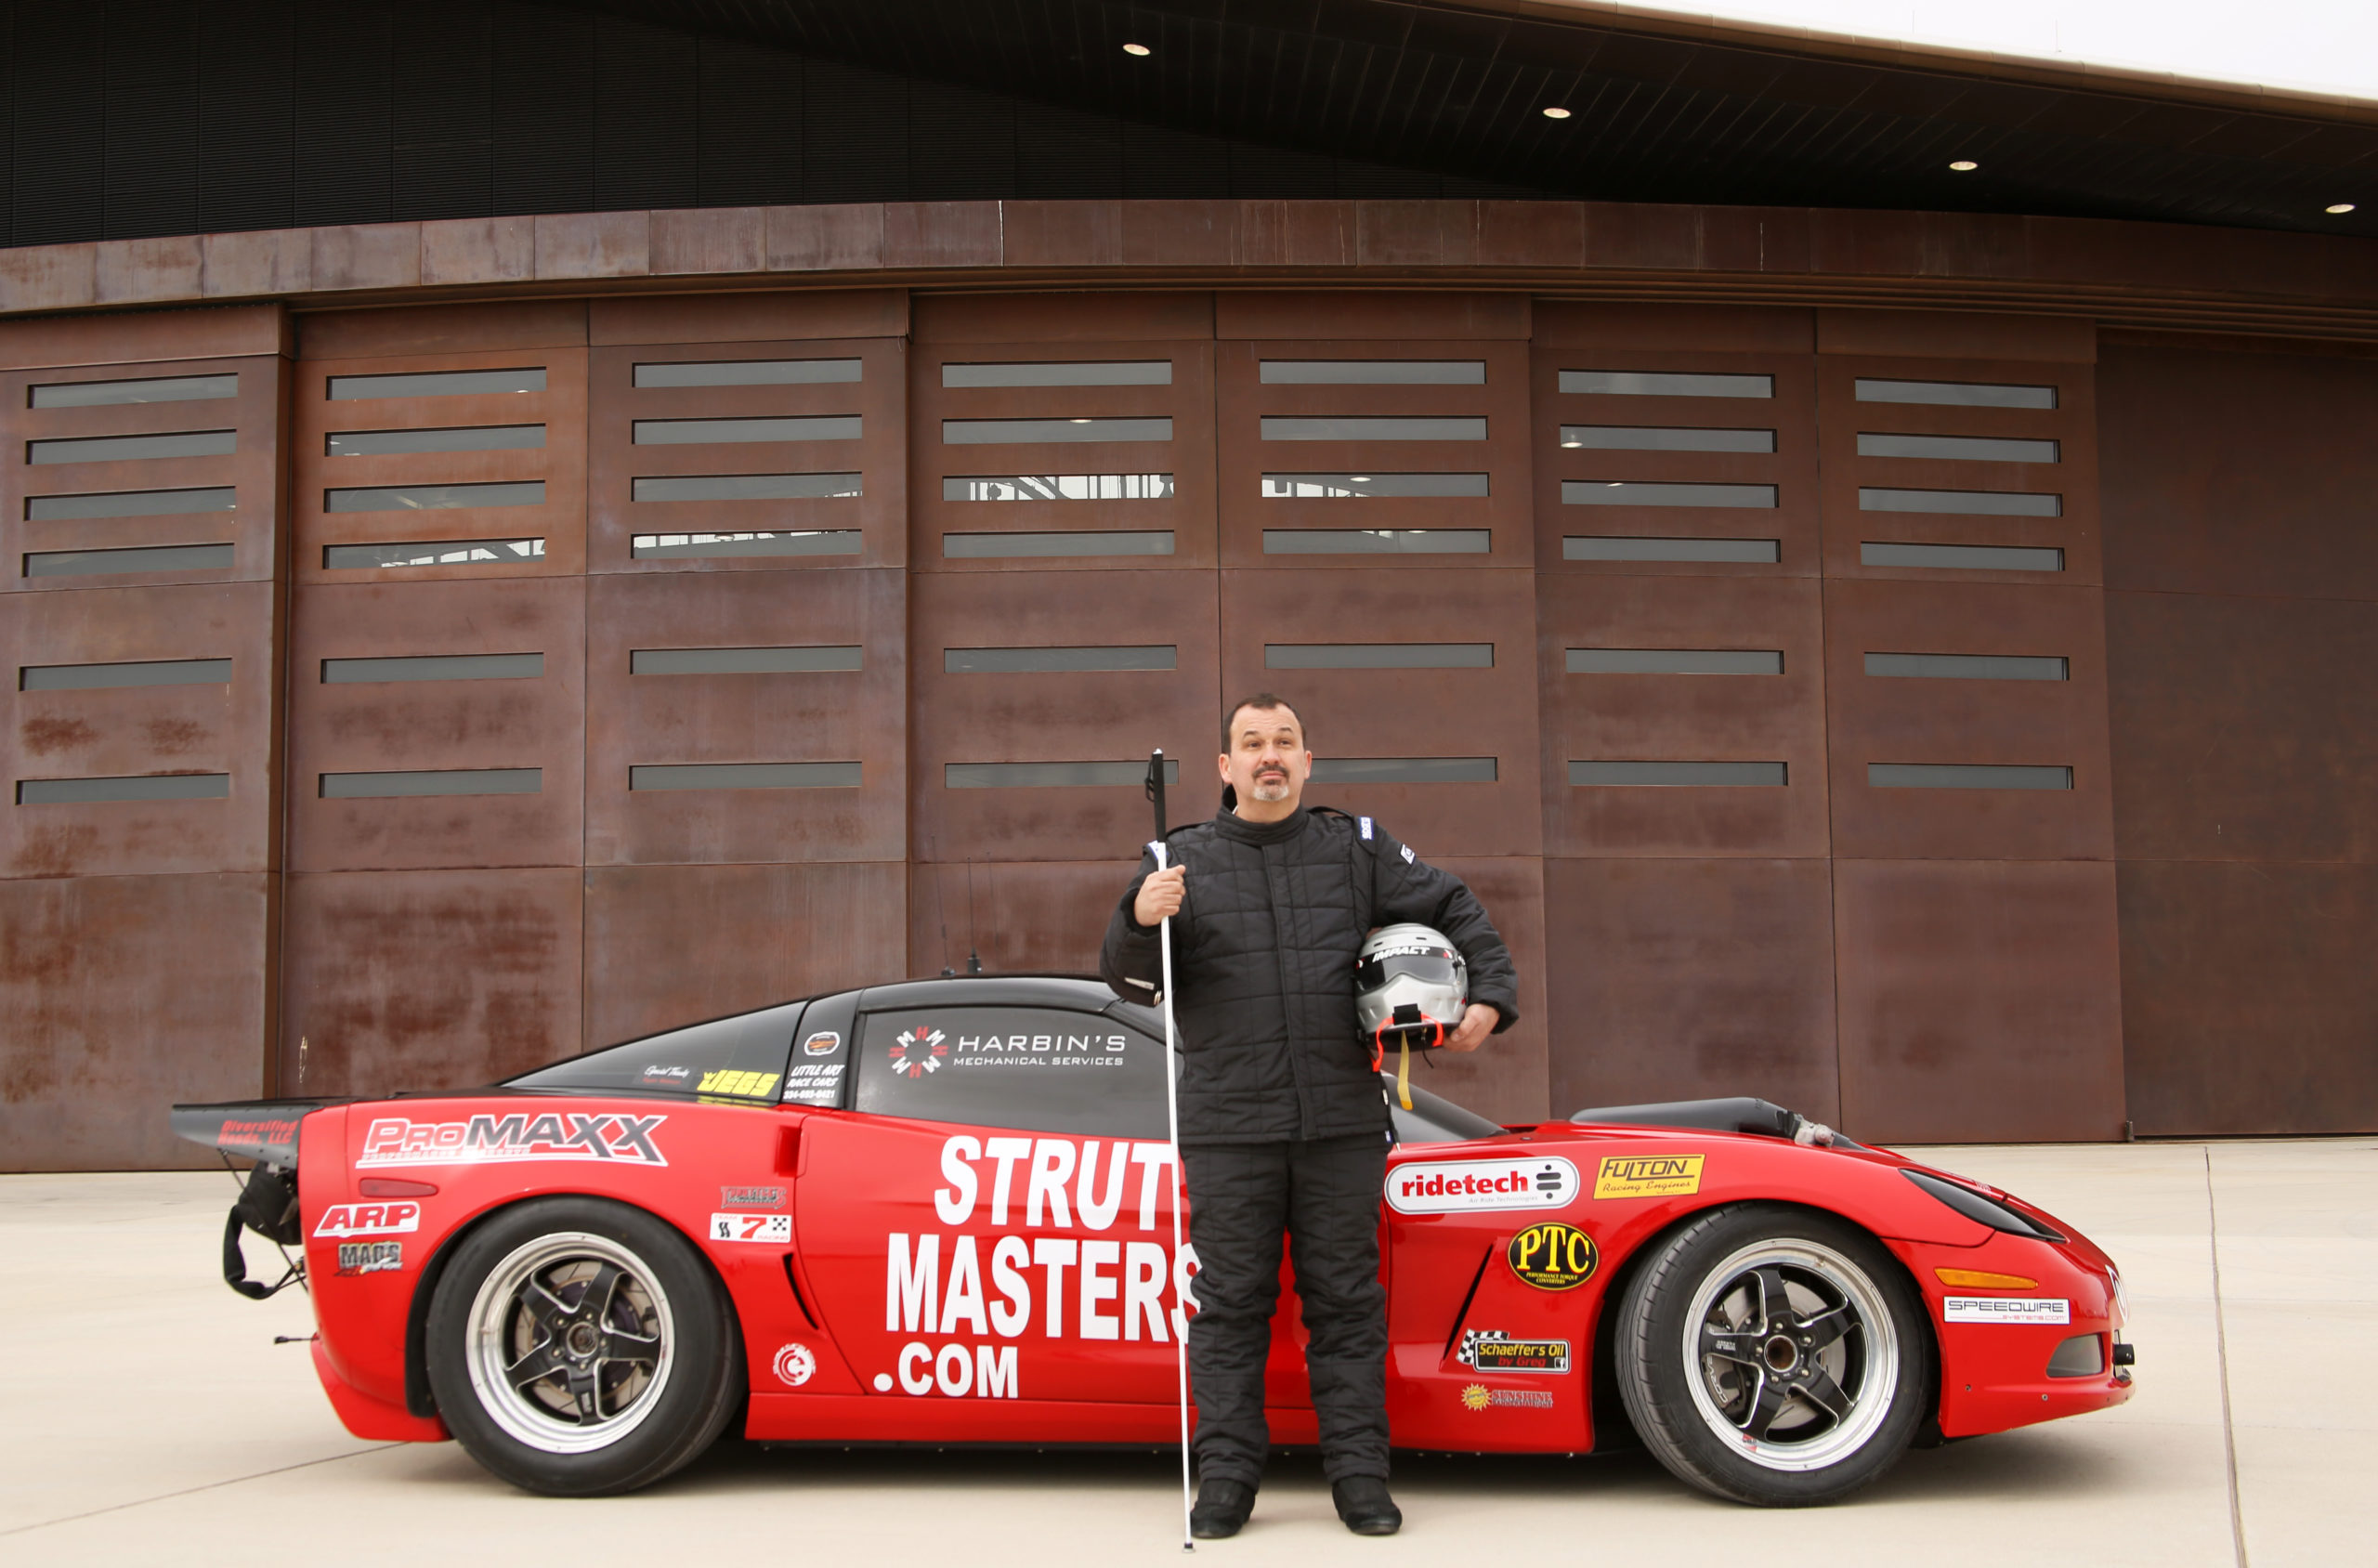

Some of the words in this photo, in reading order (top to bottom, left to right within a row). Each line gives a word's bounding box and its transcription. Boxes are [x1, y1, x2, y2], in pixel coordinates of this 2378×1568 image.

[1372, 946, 1431, 963] IMPACT
[958, 1035, 1126, 1052] HARBIN'S
[954, 1057, 1047, 1066] MECHANICAL
[1052, 1057, 1124, 1066] SERVICES
[790, 1065, 824, 1078] LITTLE
[821, 1065, 845, 1077] ART
[698, 1070, 780, 1097] JEGS
[787, 1078, 813, 1088] RACE
[812, 1078, 840, 1087] CARS
[221, 1119, 299, 1132] Diversified
[268, 1132, 293, 1144] LLC
[1601, 1157, 1694, 1181] FULTON
[934, 1135, 1179, 1231] STRUT
[1402, 1170, 1529, 1196] ridetech
[1602, 1183, 1641, 1193] Racing
[1645, 1181, 1691, 1191] Engines
[320, 1204, 417, 1230] ARP
[740, 1216, 767, 1239] 7
[1517, 1226, 1589, 1274] PTC
[886, 1232, 1203, 1345] MASTERS
[1948, 1300, 2064, 1313] SPEEDWIRE
[1479, 1343, 1546, 1356] Schaeffer's
[1548, 1344, 1565, 1356] Oil
[873, 1341, 1019, 1398] .COM
[1497, 1356, 1514, 1367] by
[1516, 1357, 1547, 1368] Greg
